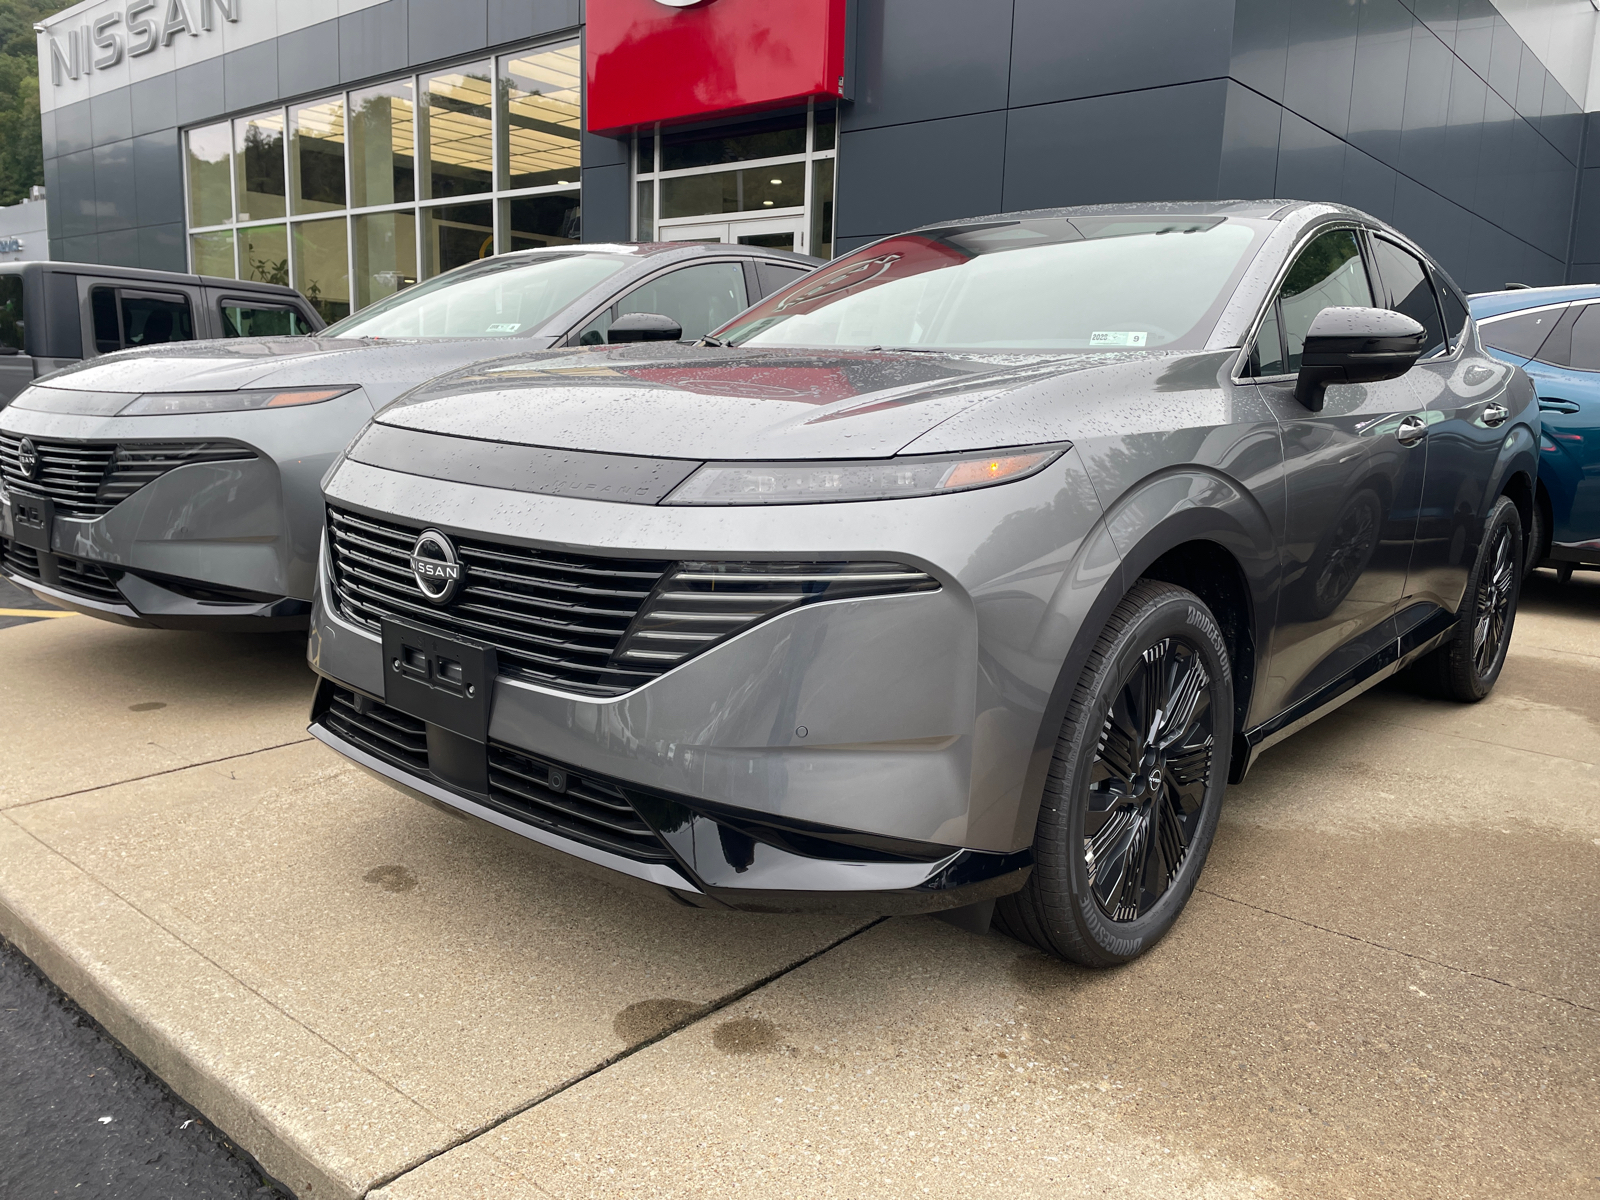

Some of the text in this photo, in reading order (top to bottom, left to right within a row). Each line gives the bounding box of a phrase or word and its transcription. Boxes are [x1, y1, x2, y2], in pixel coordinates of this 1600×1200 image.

[50, 0, 238, 86] NISSAN
[410, 557, 457, 578] NISSAN
[1186, 605, 1231, 687] BRIDGESTONE
[1080, 892, 1143, 956] BRIDGESTONE
